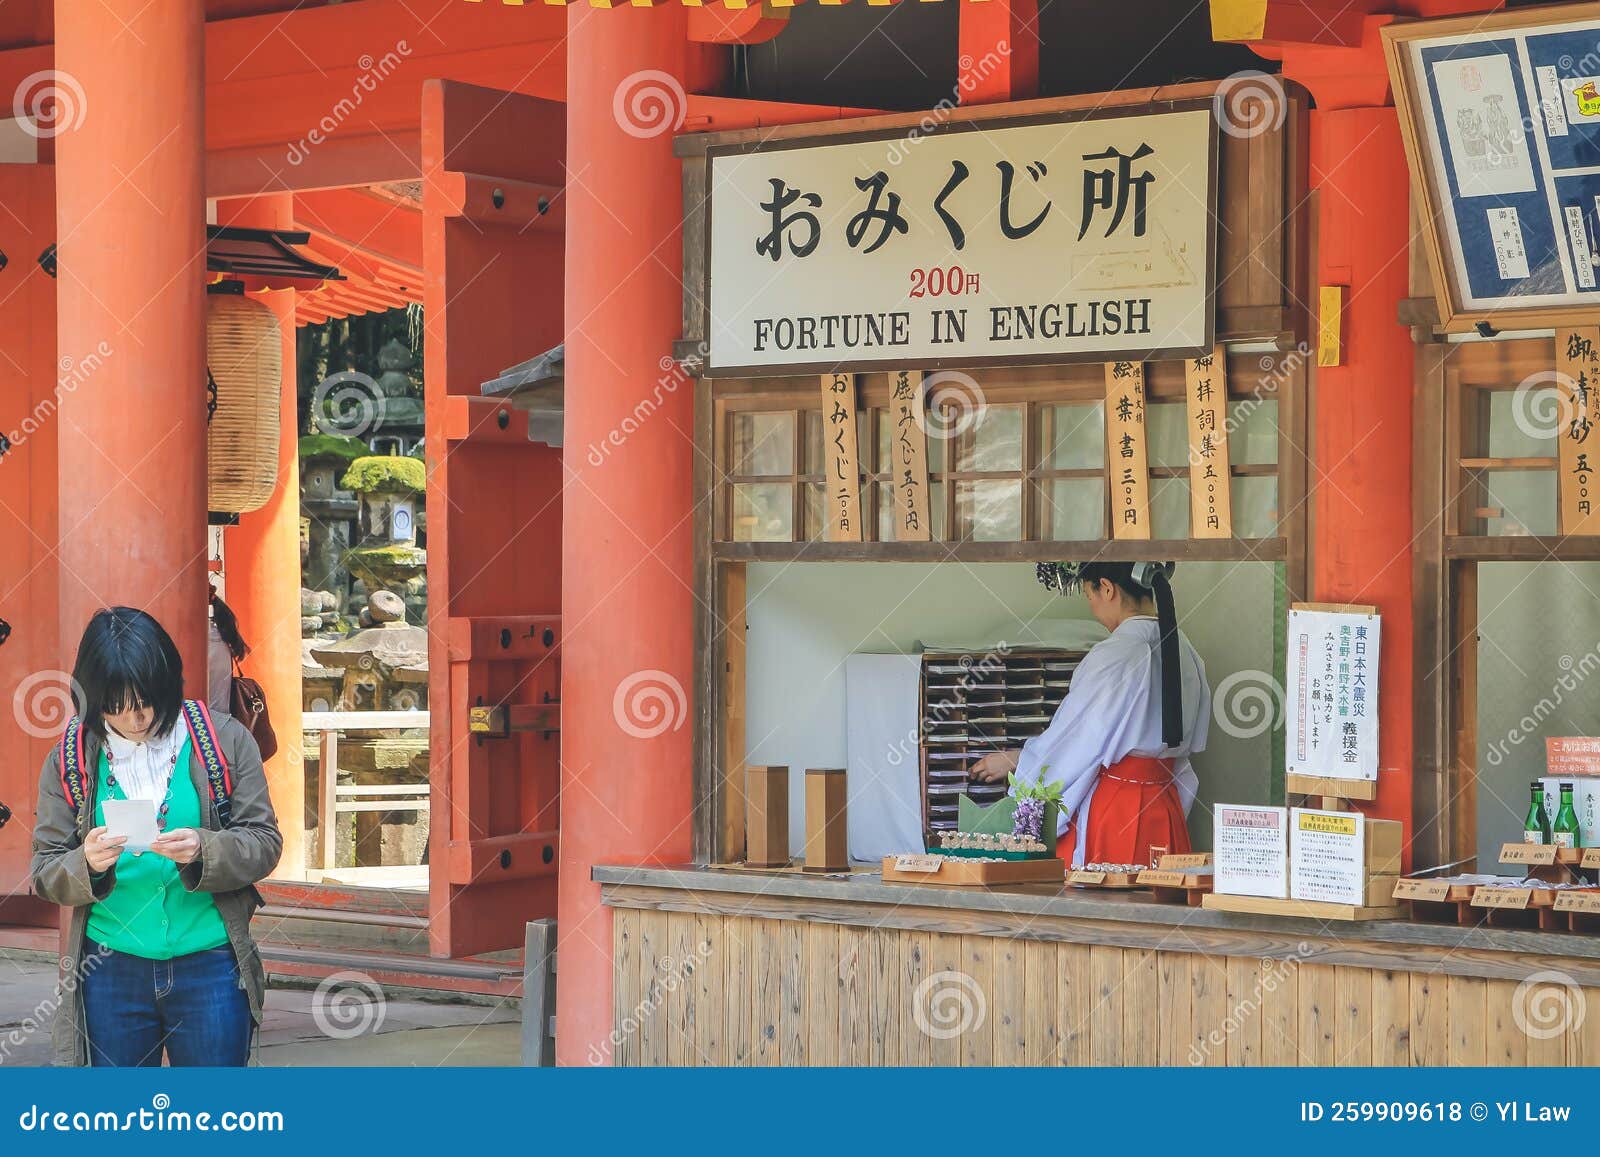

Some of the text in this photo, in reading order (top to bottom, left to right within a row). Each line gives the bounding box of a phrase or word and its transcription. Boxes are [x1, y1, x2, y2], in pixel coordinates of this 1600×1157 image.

[755, 142, 1157, 262] おみくじ所
[909, 265, 981, 299] 200円
[753, 299, 1152, 352] FORTUNE IN ENGLISH
[1352, 625, 1369, 718] 東日本大震災
[1311, 678, 1322, 750] お願いします
[1341, 721, 1358, 764] 義援金
